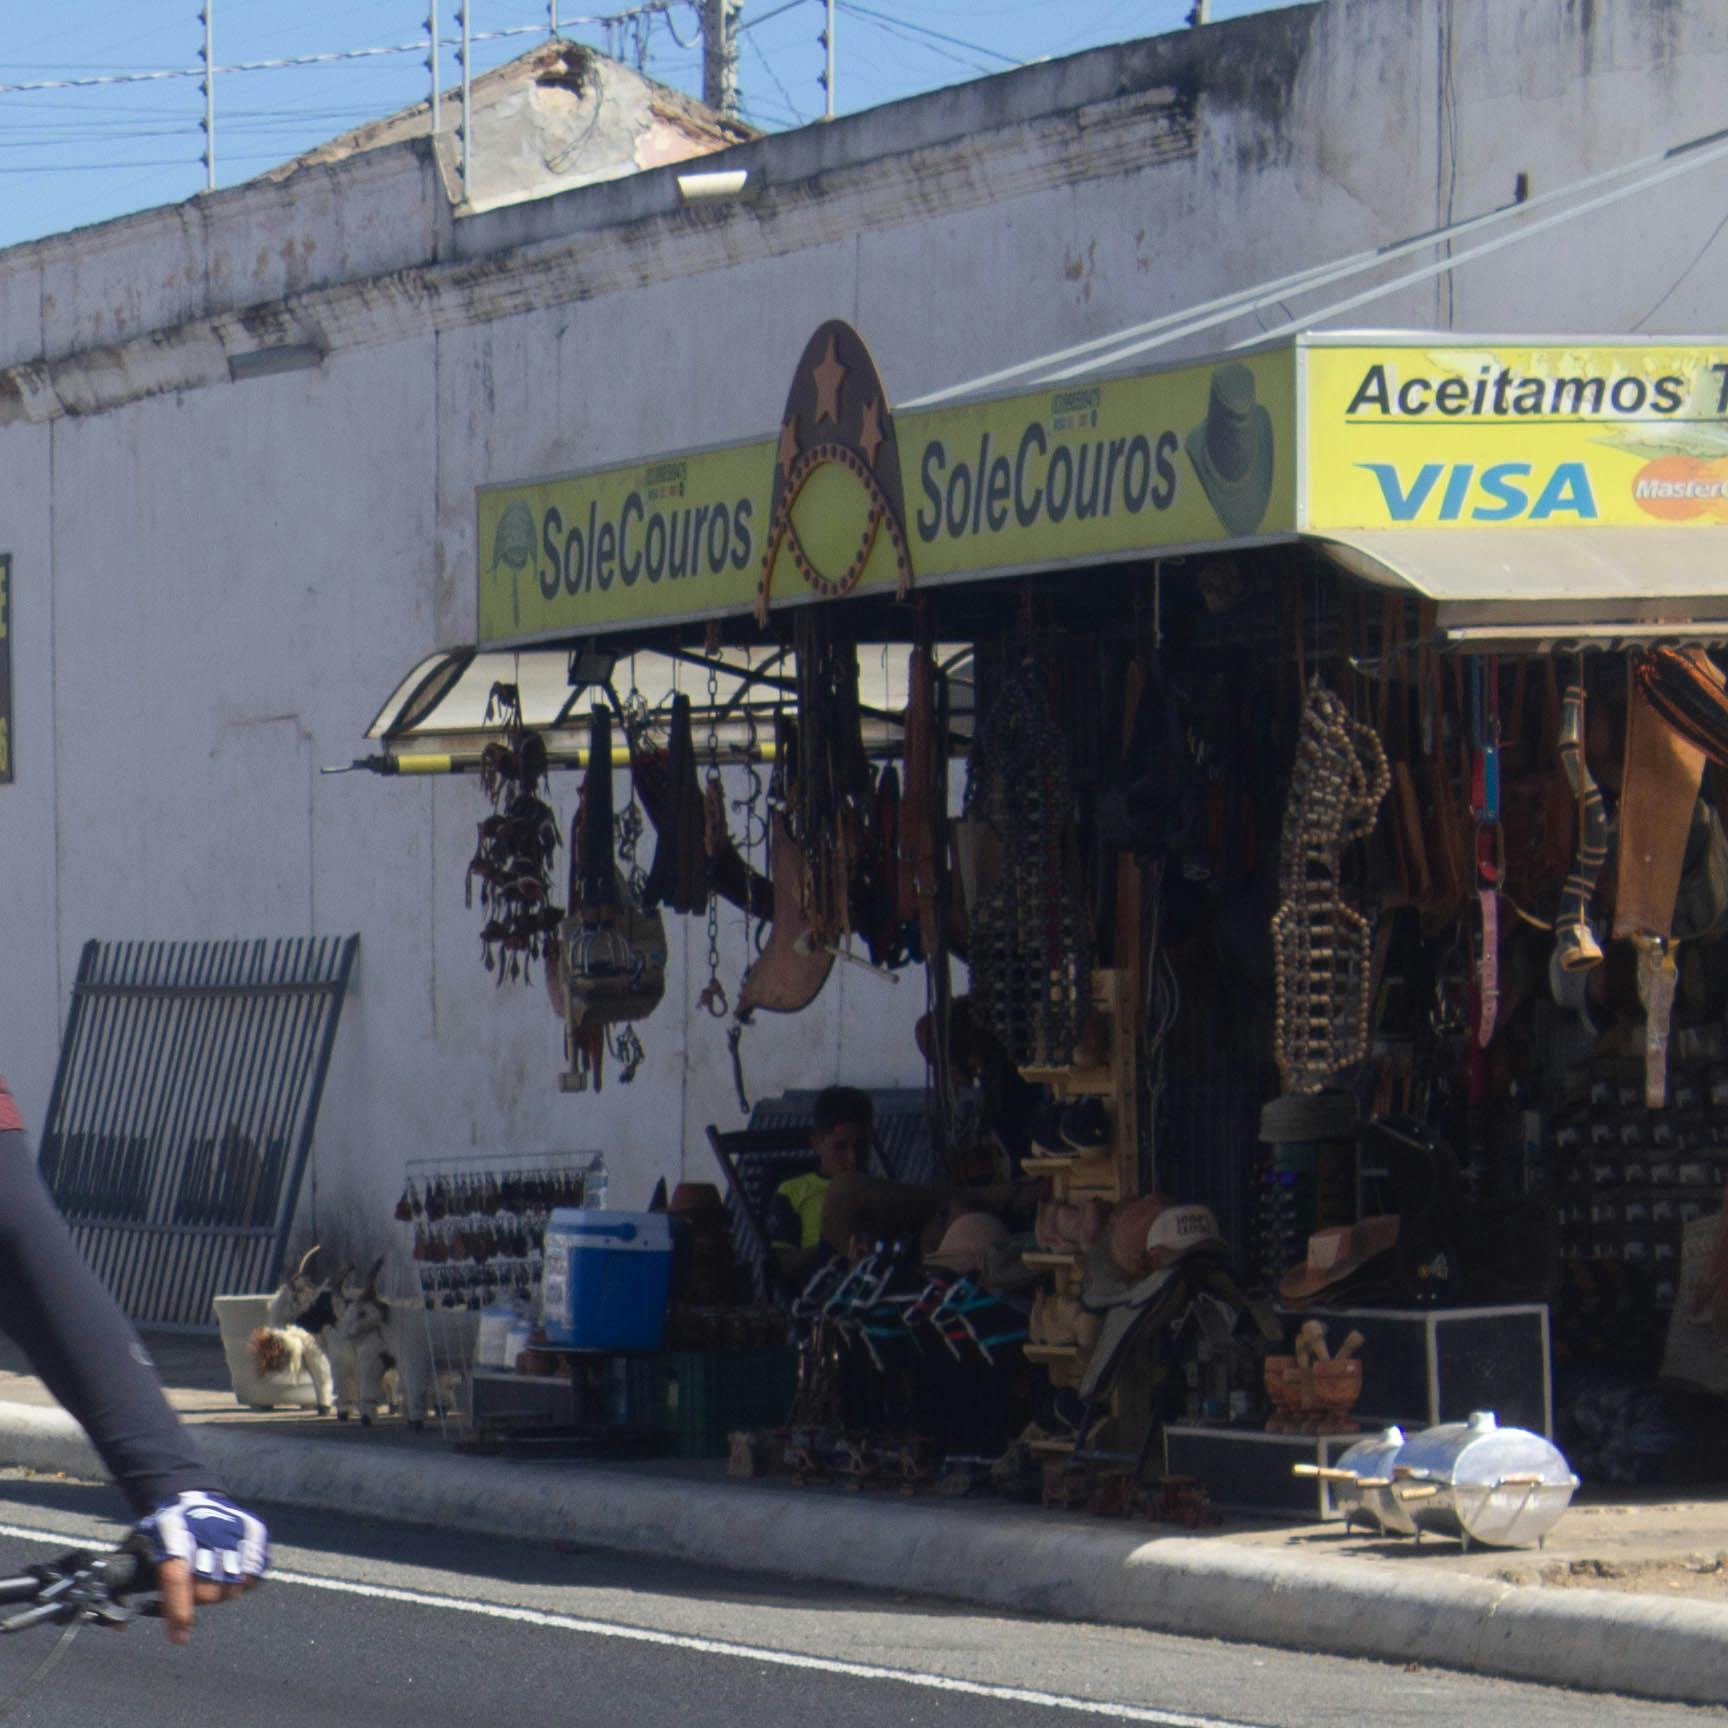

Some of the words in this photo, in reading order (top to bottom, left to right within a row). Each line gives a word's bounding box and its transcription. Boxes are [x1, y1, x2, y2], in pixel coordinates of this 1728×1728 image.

[1346, 364, 1684, 416] Aceitamos
[916, 422, 1178, 542] SoleCouros
[1353, 462, 1598, 522] VISA
[540, 491, 752, 600] SoleCouros
